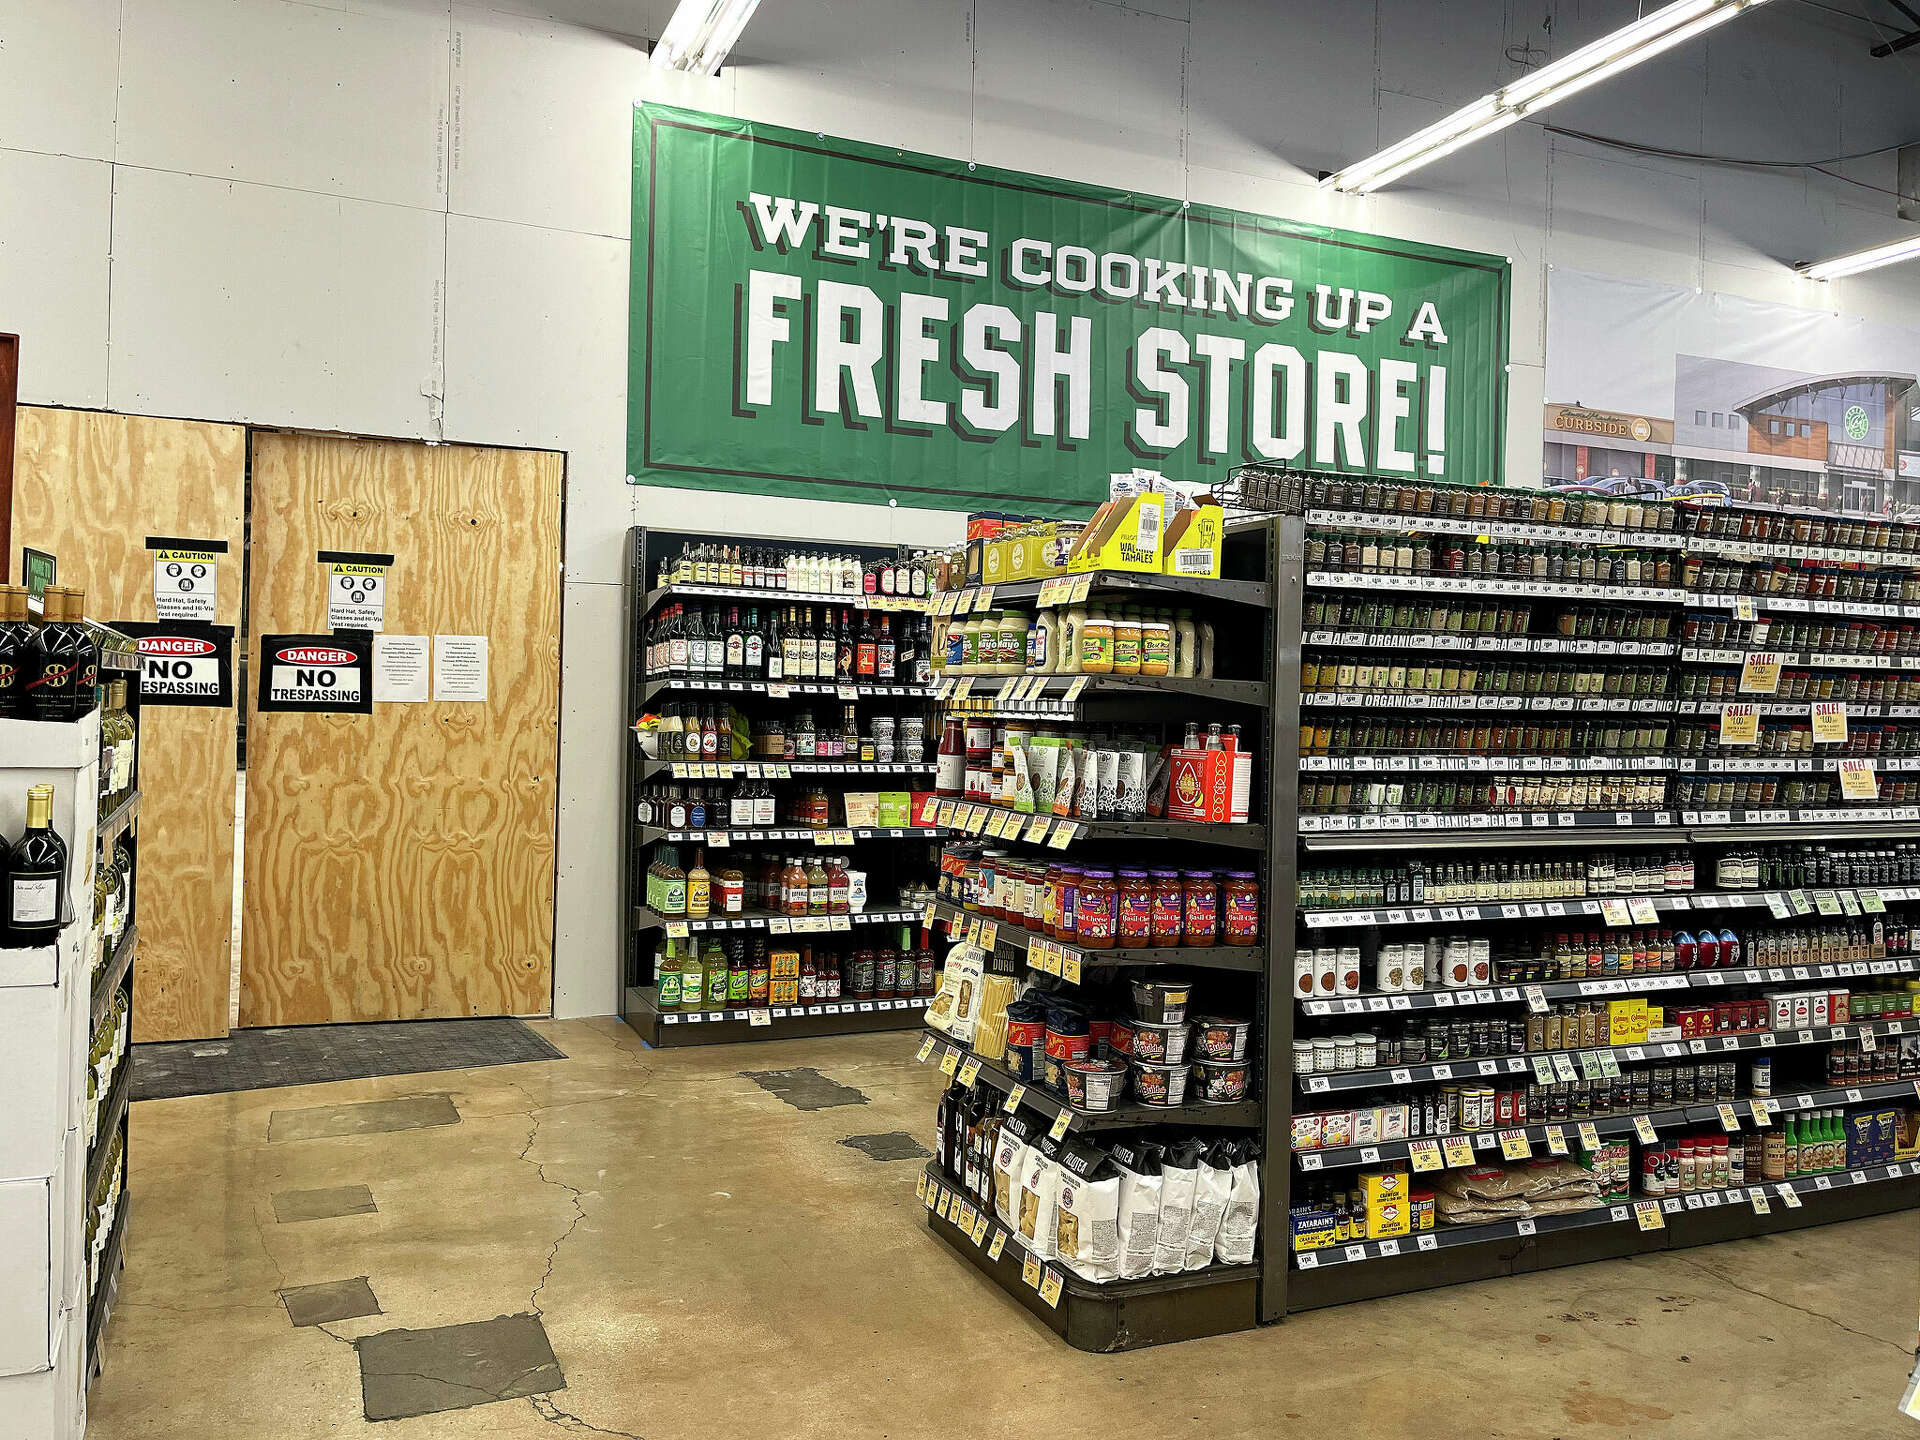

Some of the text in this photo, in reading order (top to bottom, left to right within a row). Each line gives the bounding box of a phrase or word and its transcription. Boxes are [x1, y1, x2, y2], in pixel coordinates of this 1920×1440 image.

[749, 192, 1448, 344] WE'RE COOKING UP A
[747, 269, 1446, 475] FRESH STORE!
[1554, 416, 1627, 435] CURBSIDE
[172, 552, 213, 560] CAUTION
[1121, 552, 1153, 564] TAMALES
[138, 640, 204, 652] DANGER
[287, 651, 347, 661] DANGER
[1750, 654, 1775, 666] SALE!
[148, 660, 192, 679] NO
[296, 669, 336, 687] NO
[141, 681, 218, 694] ESPASSING
[272, 689, 359, 701] TRESPASSING
[1727, 704, 1753, 717] SALE!
[1816, 703, 1839, 716] SALE!
[1842, 760, 1866, 773] SALE!
[993, 958, 1014, 973] DURO
[1445, 1136, 1465, 1147] SALE!
[1501, 1130, 1522, 1141] SALE!
[1411, 1141, 1433, 1152] SALE!
[1063, 1152, 1088, 1174] FILOTEA
[1411, 1202, 1433, 1211] OLD BAY
[1636, 1202, 1655, 1211] SALE!
[1298, 1217, 1334, 1229] ZATARAIN'S
